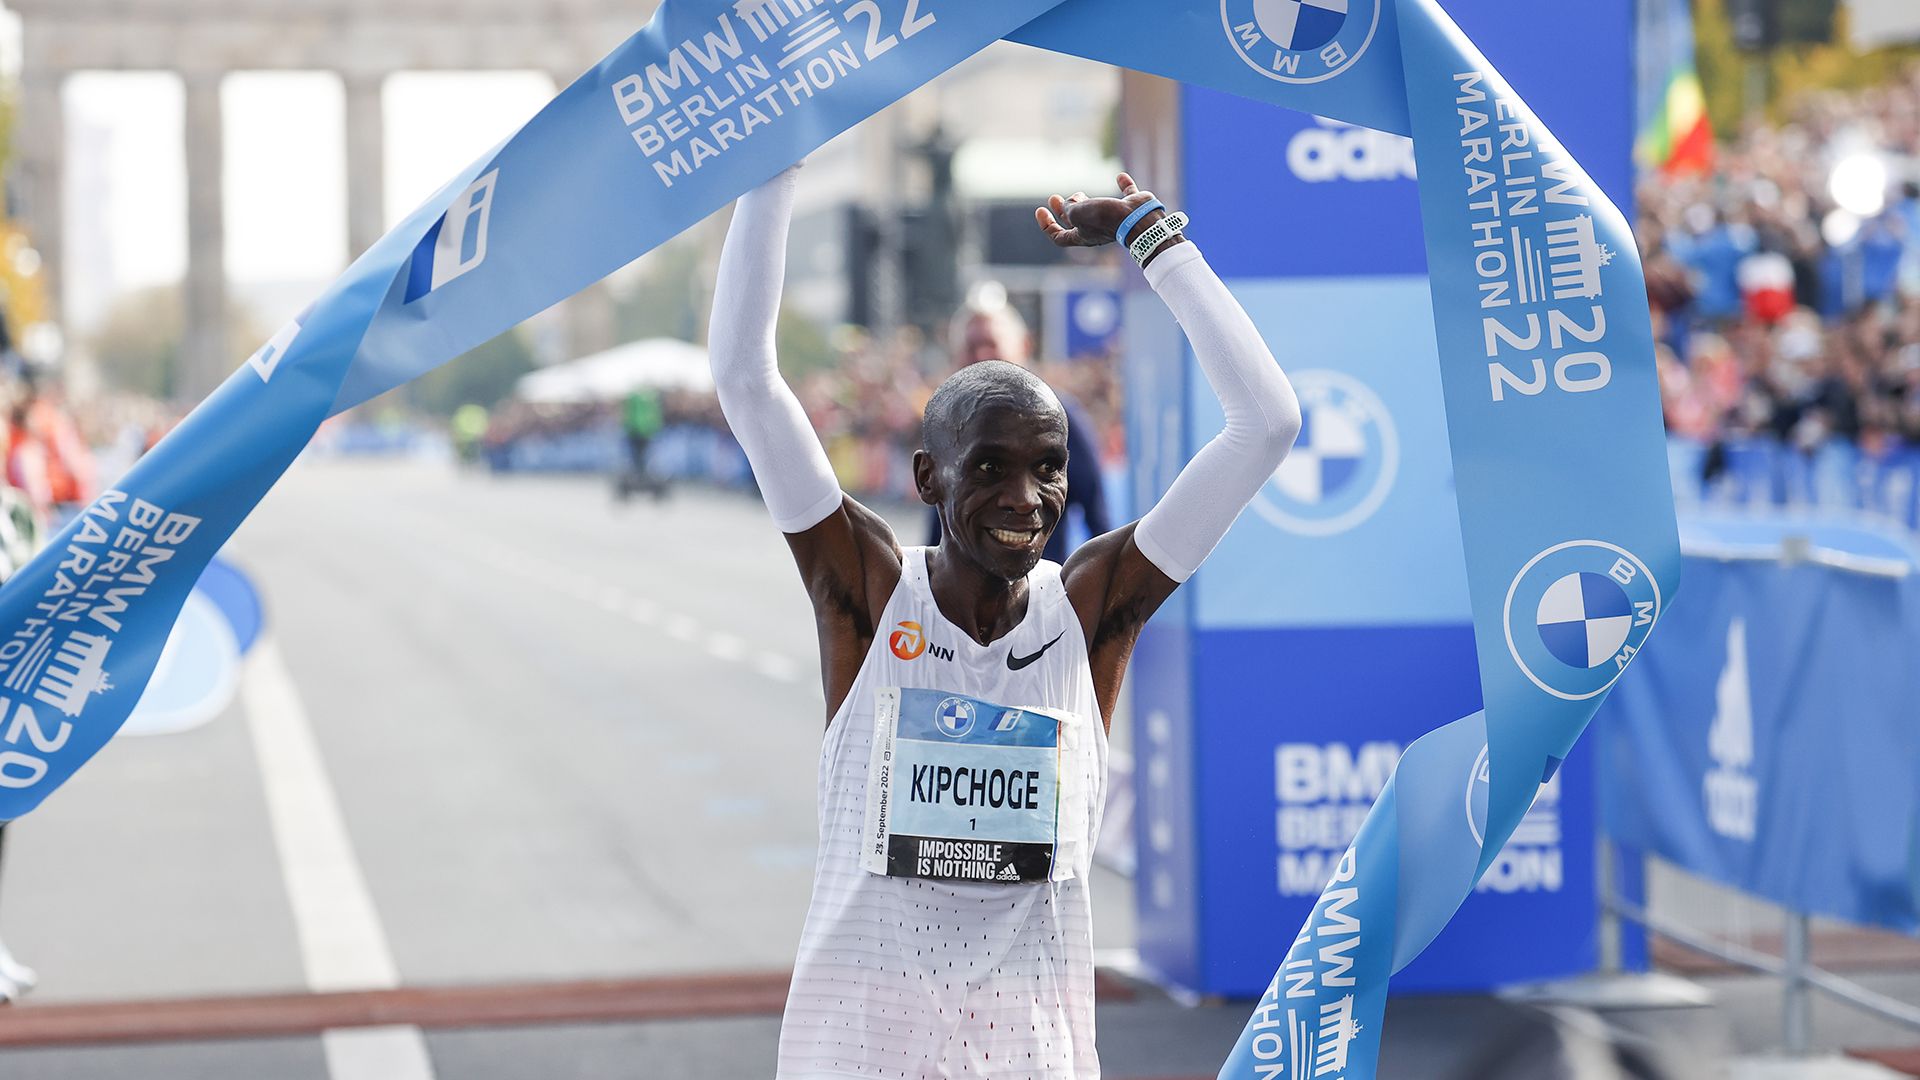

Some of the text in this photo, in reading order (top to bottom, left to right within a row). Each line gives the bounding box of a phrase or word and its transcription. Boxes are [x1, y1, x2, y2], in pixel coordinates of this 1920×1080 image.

[611, 12, 744, 126] BMW
[631, 54, 771, 157] BERLIN
[652, 40, 861, 188] MARATHON
[1494, 98, 1539, 216] ERLIN
[1453, 71, 1511, 309] MARATHON
[1482, 313, 1548, 402] 22
[1547, 305, 1612, 393] 20
[0, 489, 128, 672] MARATHO
[57, 498, 164, 622] BERLIN
[88, 513, 202, 632] BMW
[929, 642, 954, 662] NN
[1608, 557, 1654, 671] BMW
[877, 790, 887, 840] September
[881, 765, 889, 788] 2022
[911, 763, 1040, 810] KIPCHOGE
[917, 858, 997, 880] IS NOTHING
[918, 840, 1002, 862] IMPOSSIBLE
[969, 818, 976, 831] 1
[996, 873, 1021, 881] adidas
